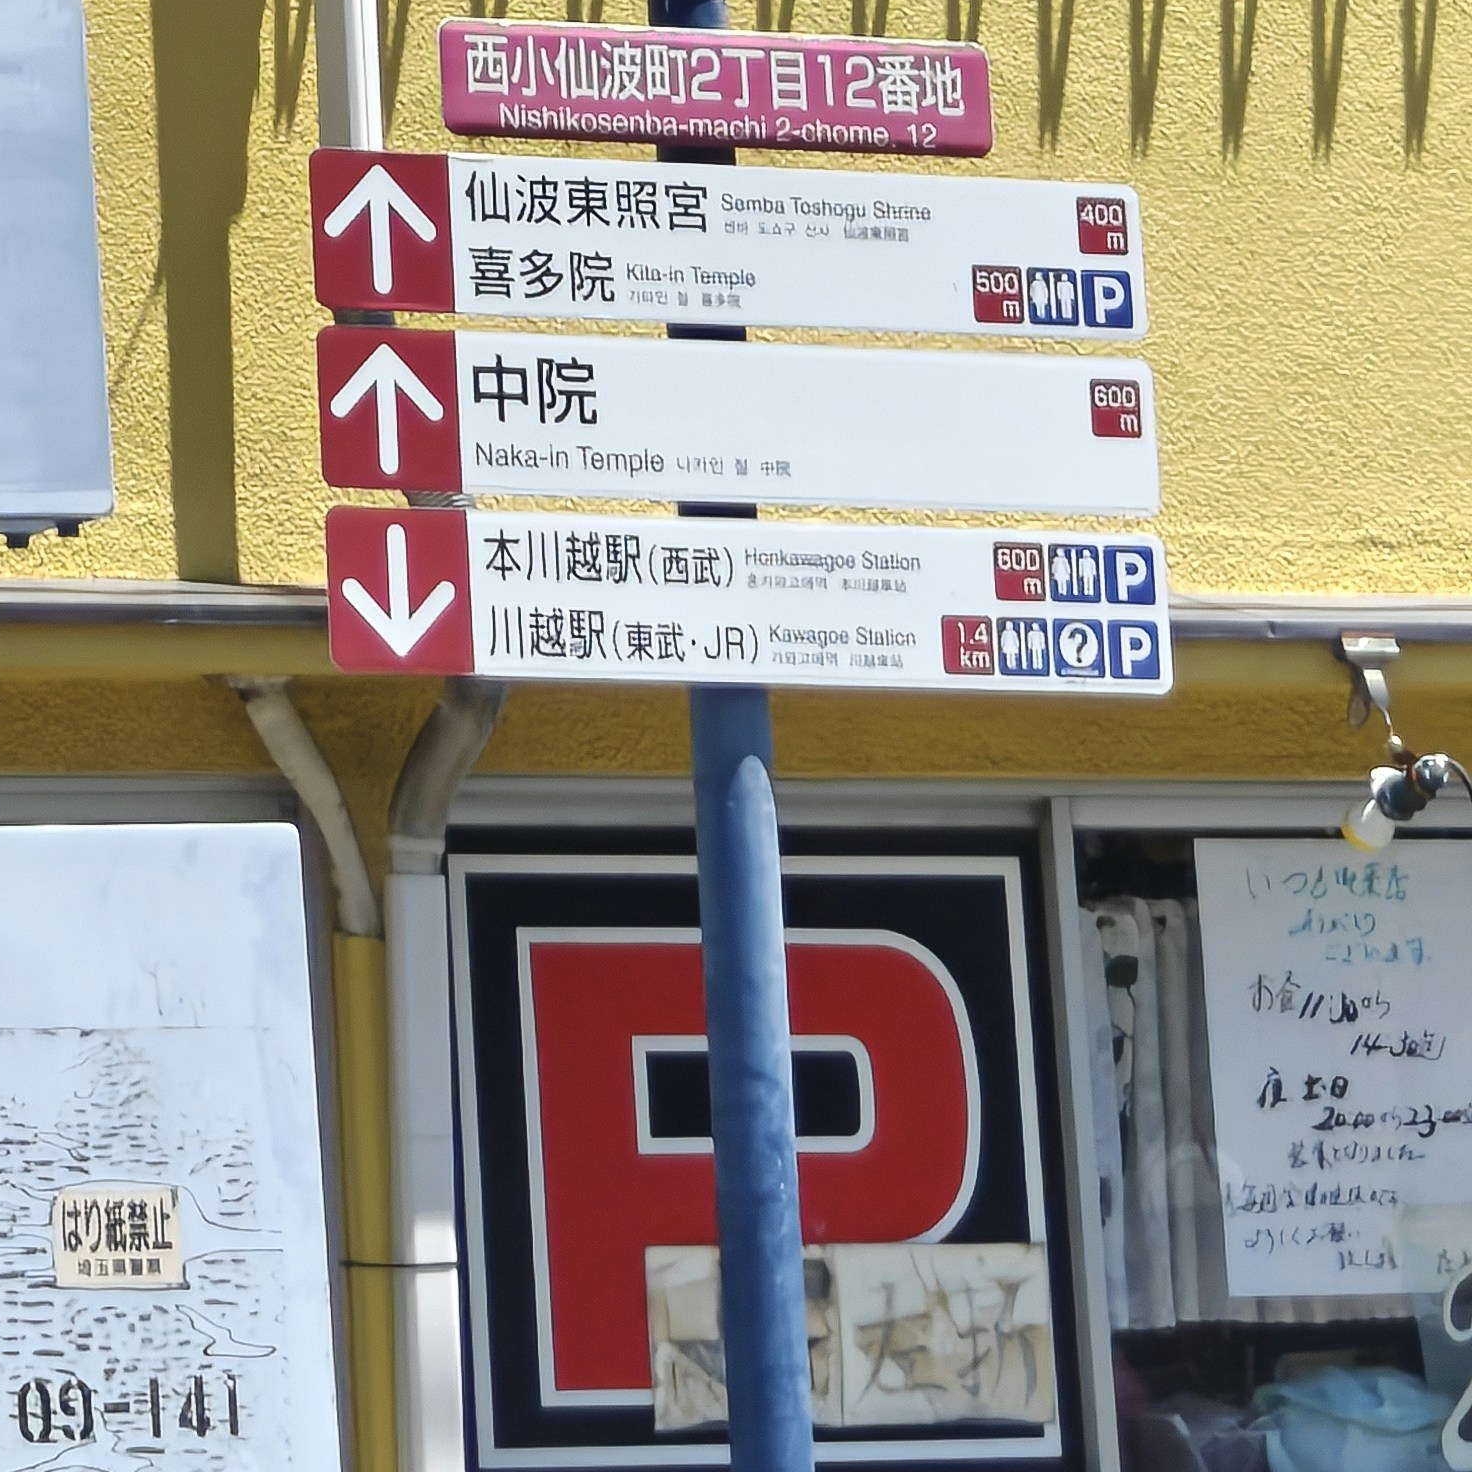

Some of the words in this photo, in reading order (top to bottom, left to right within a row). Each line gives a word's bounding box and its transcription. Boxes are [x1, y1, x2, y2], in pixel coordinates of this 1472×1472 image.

[464, 34, 966, 117] 西小仙波町2丁目12番地
[498, 105, 768, 140] Nishikosenba-machi
[906, 123, 938, 148] 12
[465, 170, 708, 234] 仙波東照宮
[790, 196, 867, 223] Toshogu
[1080, 203, 1124, 226] 400
[1107, 231, 1125, 251] m
[468, 245, 615, 303] 喜多院
[690, 265, 756, 290] Temple
[975, 271, 1019, 295] 500
[1002, 300, 1021, 320] m
[472, 353, 598, 425] 中院
[1093, 385, 1137, 409] 600
[1119, 413, 1139, 433] m
[474, 442, 569, 469] Naka-in
[576, 446, 665, 479] Temple
[483, 528, 734, 589] 本川越駅(西武)
[862, 550, 921, 571] Station
[997, 548, 1041, 571] 600
[1023, 576, 1043, 596] m
[768, 624, 850, 649] Kawagoe
[855, 626, 917, 647] Station
[957, 620, 988, 646] 1.4
[960, 645, 991, 669] km
[61, 1196, 174, 1254] はり紙禁止
